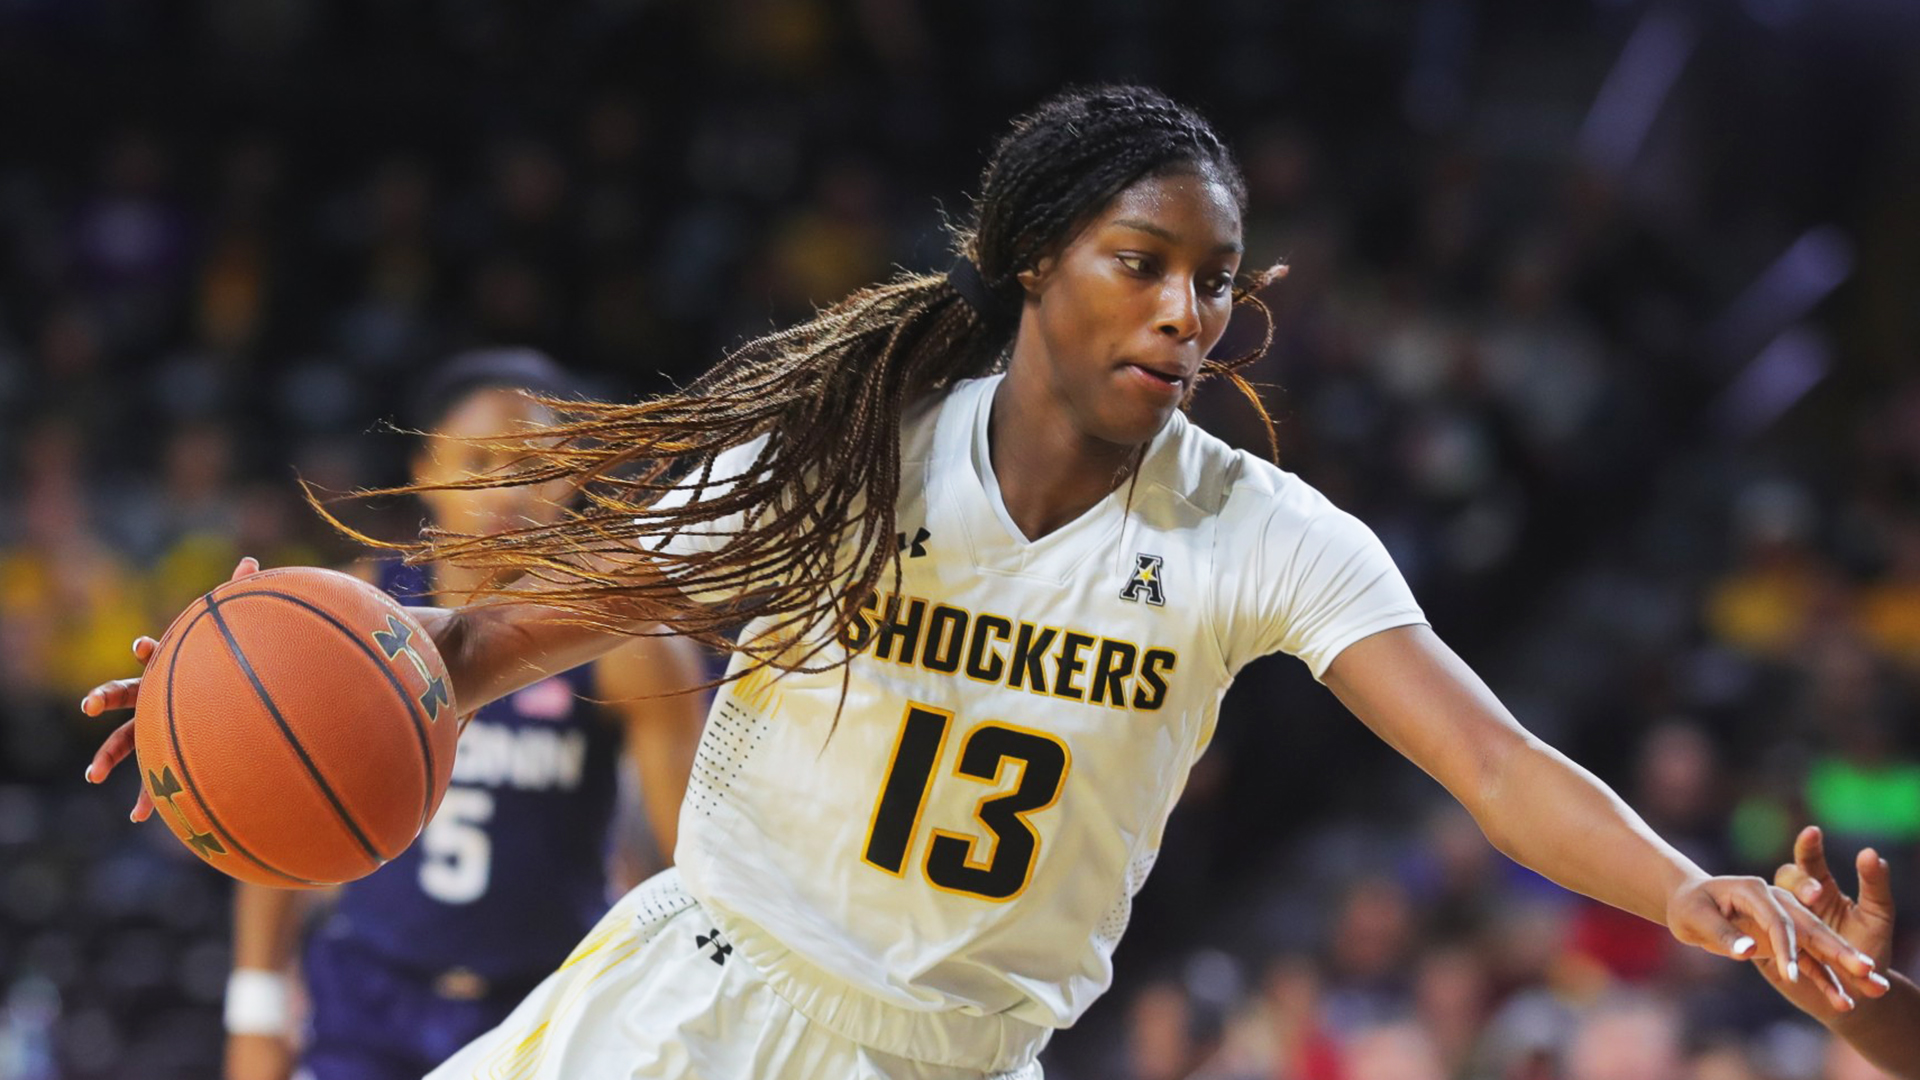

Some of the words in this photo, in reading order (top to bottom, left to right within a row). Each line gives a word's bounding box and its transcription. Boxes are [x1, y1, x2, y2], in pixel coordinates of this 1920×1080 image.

[1119, 552, 1165, 607] A
[838, 582, 1178, 713] SHOCKERS
[419, 787, 496, 903] 5
[860, 699, 1073, 904] 13
